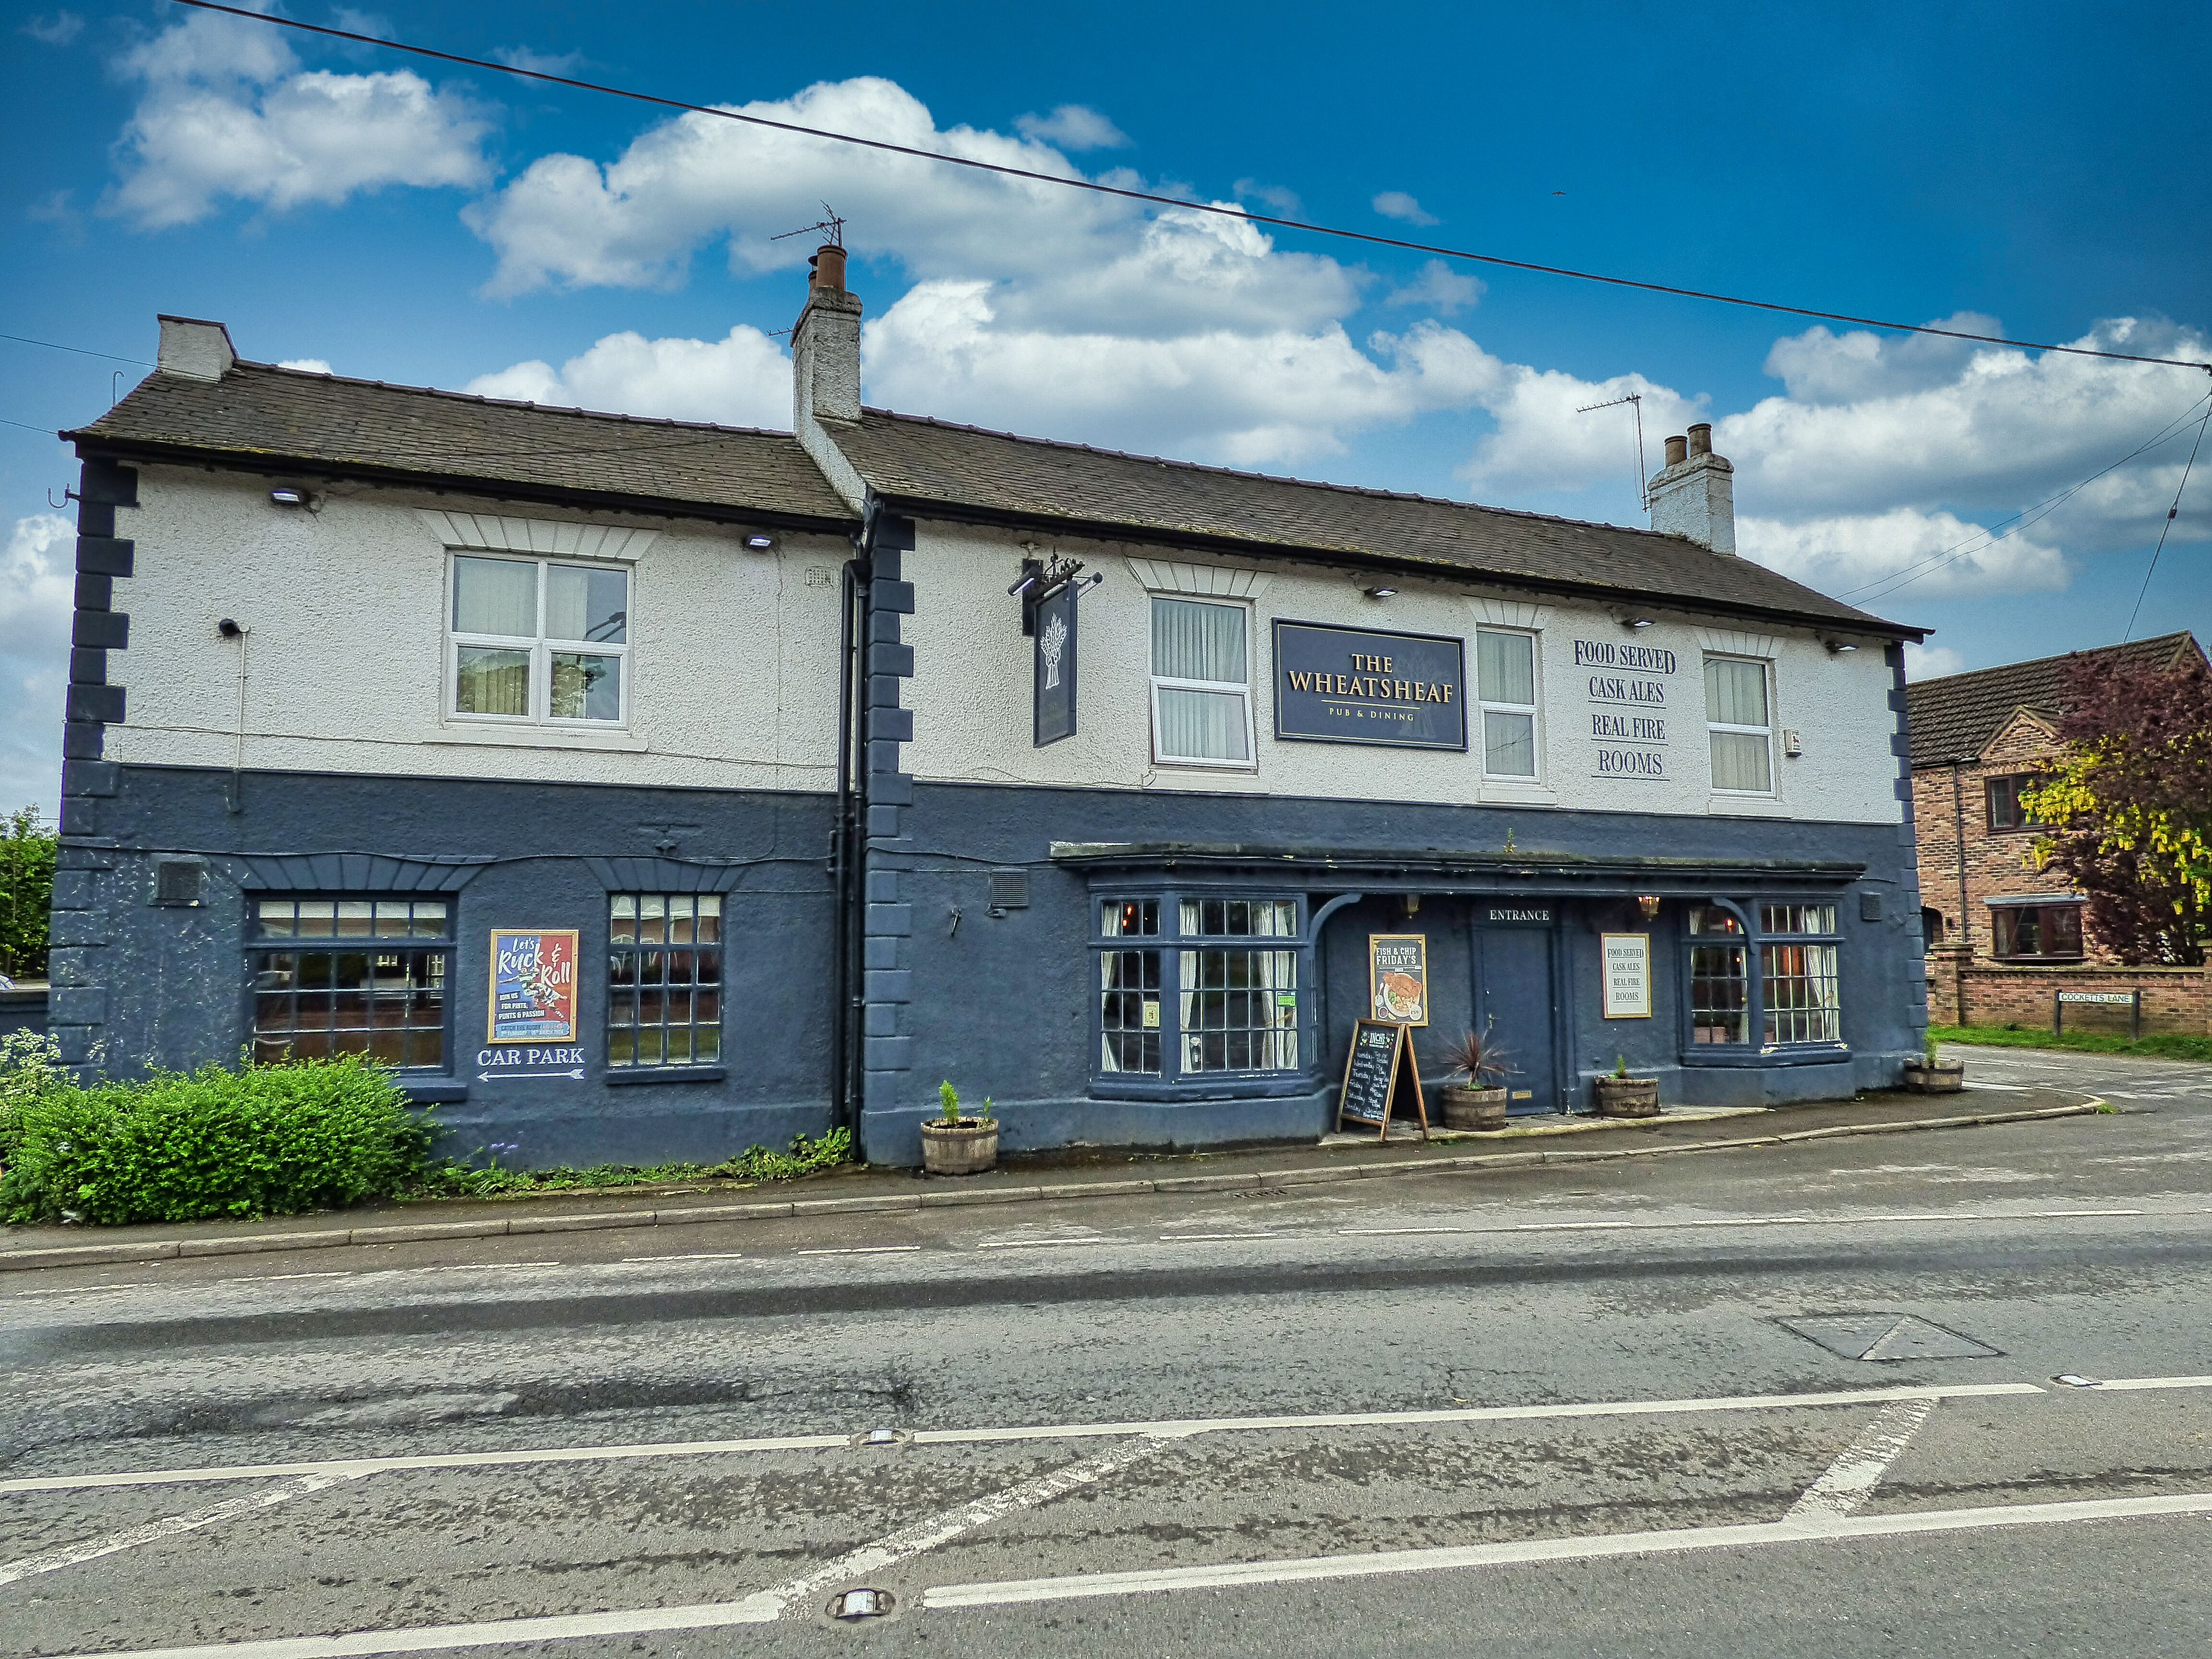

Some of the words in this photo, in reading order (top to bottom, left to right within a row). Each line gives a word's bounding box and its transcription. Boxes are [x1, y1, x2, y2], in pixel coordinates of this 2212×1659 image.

[1352, 653, 1392, 673] THE
[1574, 639, 1615, 665] FOOD
[1619, 645, 1676, 674] SERVED
[1289, 670, 1453, 703] WHEATSHEAF
[1589, 676, 1625, 699] CASK
[1629, 680, 1664, 703] ALES
[1329, 708, 1350, 717] PUB
[1370, 711, 1414, 721] DINING
[1591, 714, 1629, 737] REAL
[1632, 717, 1666, 740] FIRE
[1598, 749, 1662, 775] ROOMS
[1490, 910, 1550, 920] ENTRANCE
[513, 938, 535, 953] Let's
[1400, 947, 1417, 955] CHIP
[1608, 948, 1622, 958] FOOD
[1623, 949, 1644, 958] SERVED
[497, 943, 544, 974] Ruck
[552, 942, 563, 968] &
[1376, 955, 1416, 965] FRIDAY'S
[541, 961, 571, 987] Roll
[1613, 978, 1627, 986] REAL
[1628, 978, 1640, 986] FIRE
[1616, 992, 1639, 1000] ROOMS
[2061, 993, 2104, 1002] COCKETTS
[477, 1049, 522, 1066] CAR
[526, 1048, 585, 1065] PARK
